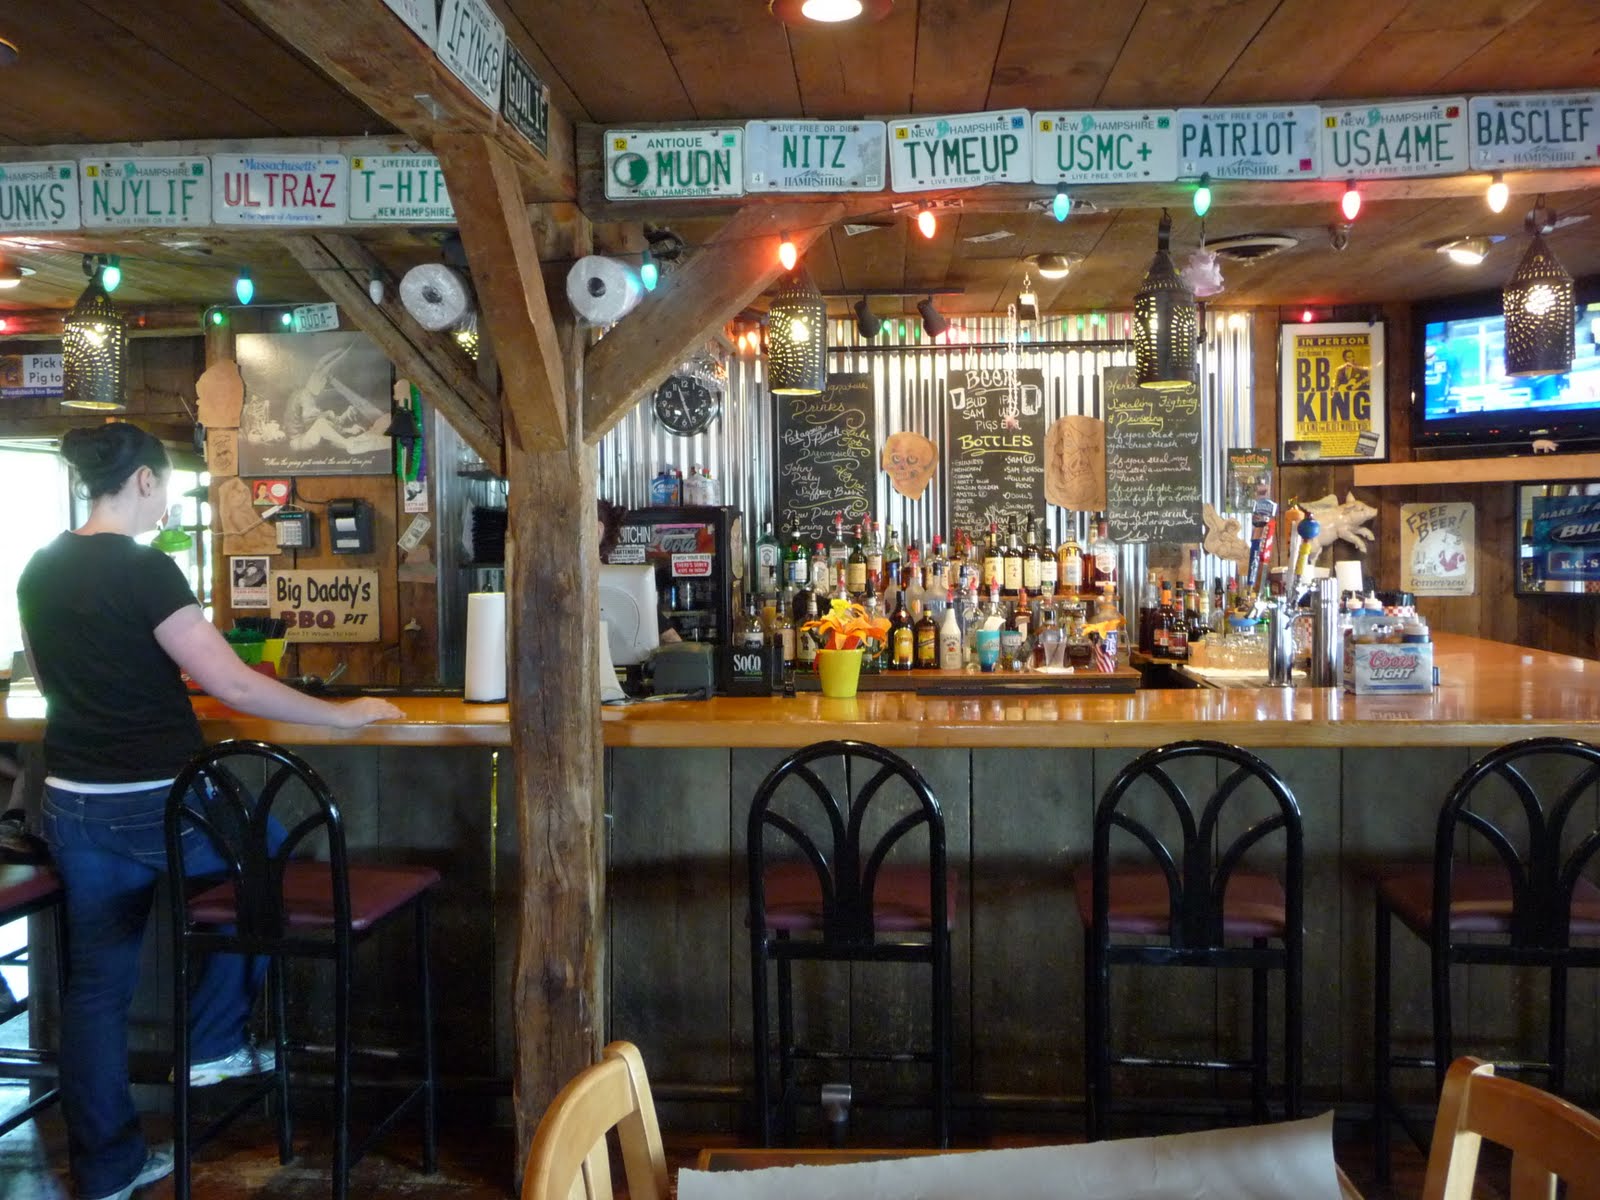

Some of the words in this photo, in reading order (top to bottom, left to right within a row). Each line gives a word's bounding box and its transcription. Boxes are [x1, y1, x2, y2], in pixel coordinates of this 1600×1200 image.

[1340, 117, 1365, 127] NEW
[1381, 110, 1443, 124] HAMPSHIRE
[777, 125, 795, 133] LIVE
[799, 125, 821, 133] FREE
[824, 125, 836, 133] OR
[839, 125, 853, 133] DIE
[911, 127, 935, 138] NEW
[950, 121, 1009, 135] HAMPSHIRE
[1055, 122, 1079, 132] NEW
[1094, 120, 1155, 131] HAMPSHIRE
[1477, 108, 1593, 146] BASCLEF
[614, 141, 625, 149] 12
[647, 137, 703, 149] ANTIQUE
[1332, 123, 1454, 168] USA4ME
[782, 135, 846, 169] NITZ
[903, 134, 1019, 179] TYMEUP
[1057, 134, 1153, 172] USMC+
[243, 158, 318, 172] Massachusetts
[382, 159, 399, 168] LIVE
[400, 159, 420, 168] FREE
[421, 159, 433, 168] OR
[657, 149, 731, 186] MUDN
[6, 173, 57, 181] HAMPSHIRE
[101, 169, 122, 177] NEW
[136, 168, 190, 177] HAMPSHIRE
[1216, 166, 1280, 177] HAMPSHIRE
[784, 177, 845, 187] HAMPSHIRE
[92, 179, 198, 216] NJYLIF
[638, 188, 657, 196] NEW
[662, 188, 712, 196] HAMPSHIRE
[377, 207, 396, 217] NEW
[399, 207, 451, 217] HAMPSHIRE
[1302, 338, 1314, 346] IN
[1318, 336, 1365, 346] PERSON
[32, 357, 56, 369] Pick
[29, 371, 48, 385] Pig
[50, 372, 62, 383] to
[789, 399, 845, 420] Drinks
[966, 396, 987, 410] BUD
[1297, 391, 1371, 422] KING
[963, 408, 985, 420] SAM
[1007, 455, 1023, 464] SAM
[1539, 507, 1575, 520] MAKE
[1578, 504, 1590, 513] IT
[1406, 505, 1448, 534] FREE
[277, 576, 301, 609] Big
[307, 576, 370, 609] Daddy's
[280, 610, 336, 629] BBQ
[343, 613, 368, 625] PIT
[1369, 651, 1417, 668] Coors
[1370, 668, 1415, 680] LIGHT
